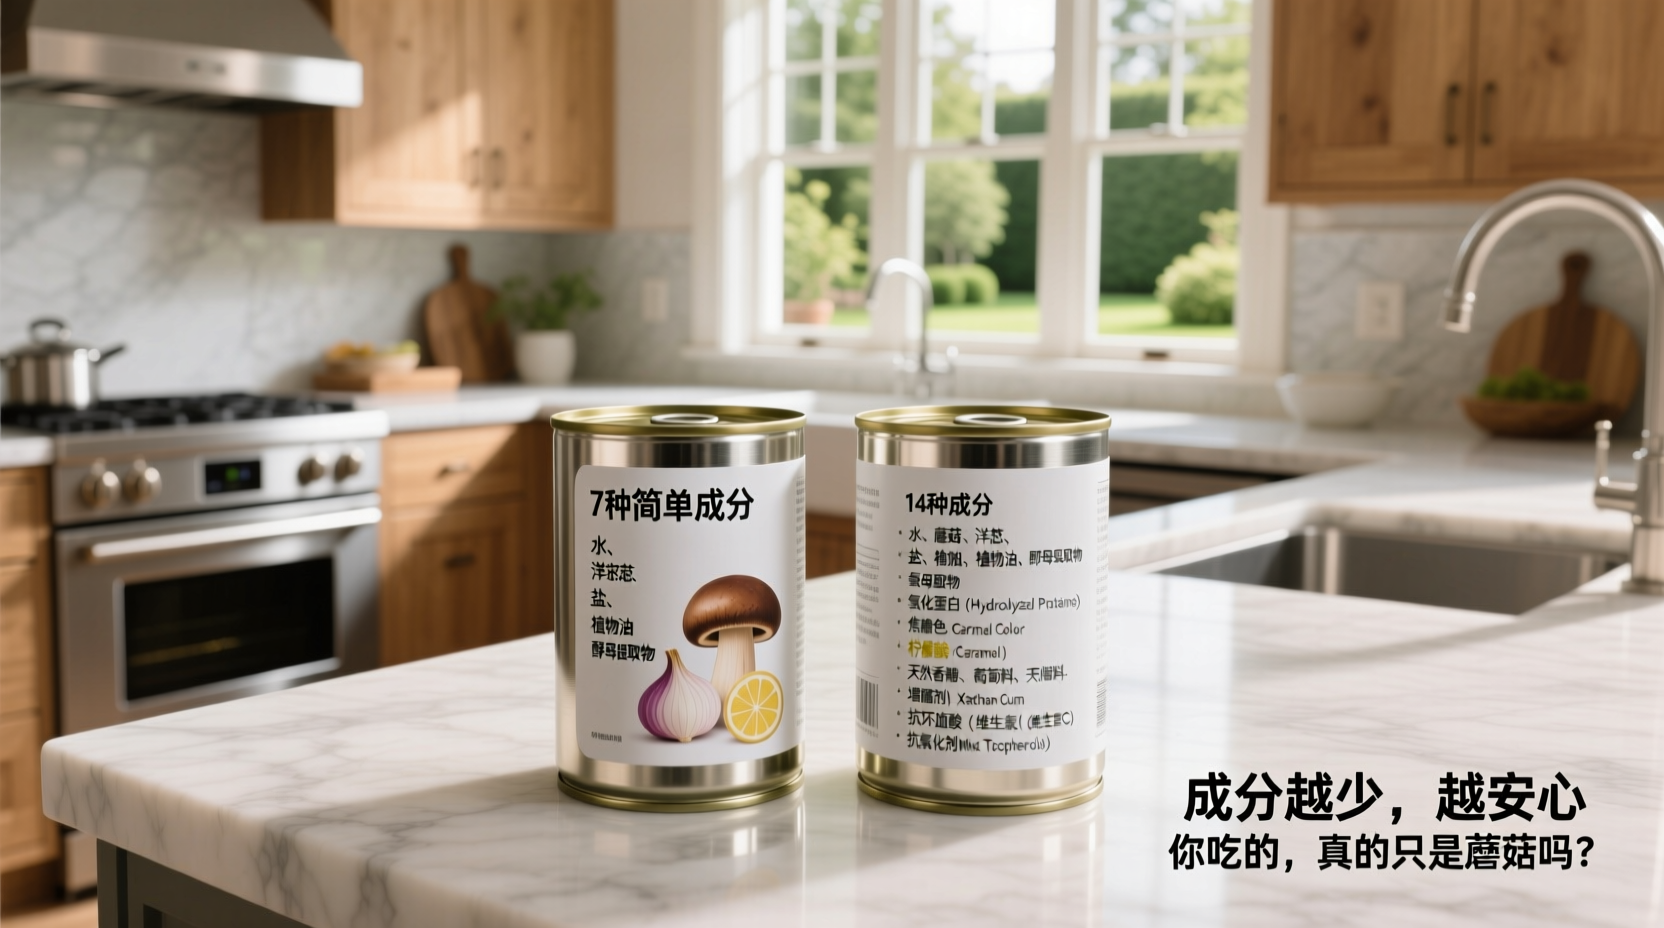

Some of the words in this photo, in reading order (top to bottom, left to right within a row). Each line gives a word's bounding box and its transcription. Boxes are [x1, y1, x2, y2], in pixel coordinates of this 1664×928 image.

[590, 487, 754, 522] 7种简单成分
[905, 492, 993, 516] 14种成分
[591, 535, 613, 556] 水、
[590, 588, 612, 608] 盐、
[995, 621, 1026, 636] Color
